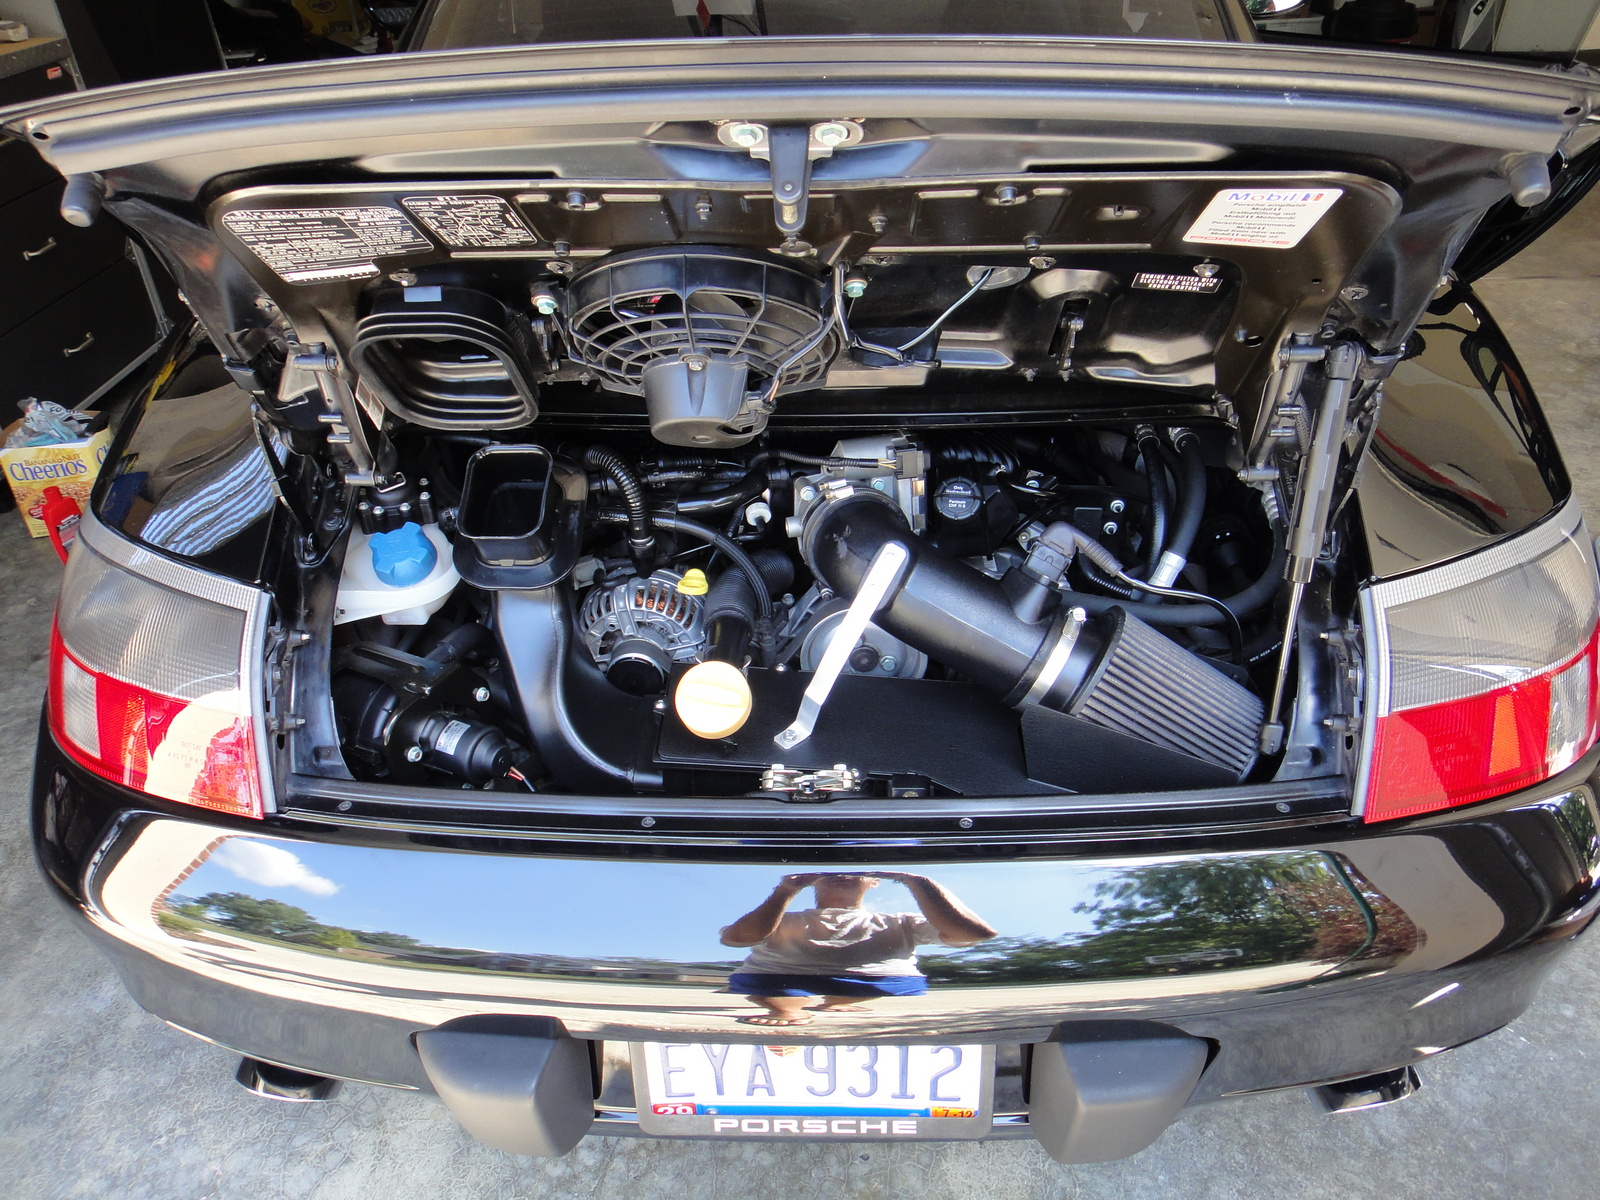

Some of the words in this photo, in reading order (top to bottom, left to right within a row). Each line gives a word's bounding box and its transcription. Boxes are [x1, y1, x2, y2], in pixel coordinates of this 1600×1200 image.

[1228, 193, 1298, 201] Mobil
[1189, 235, 1290, 245] PORSCHE
[9, 459, 88, 481] Cheerios
[659, 1043, 776, 1098] EYA
[803, 1045, 963, 1102] 9312
[713, 1118, 918, 1134] PORSCHE
